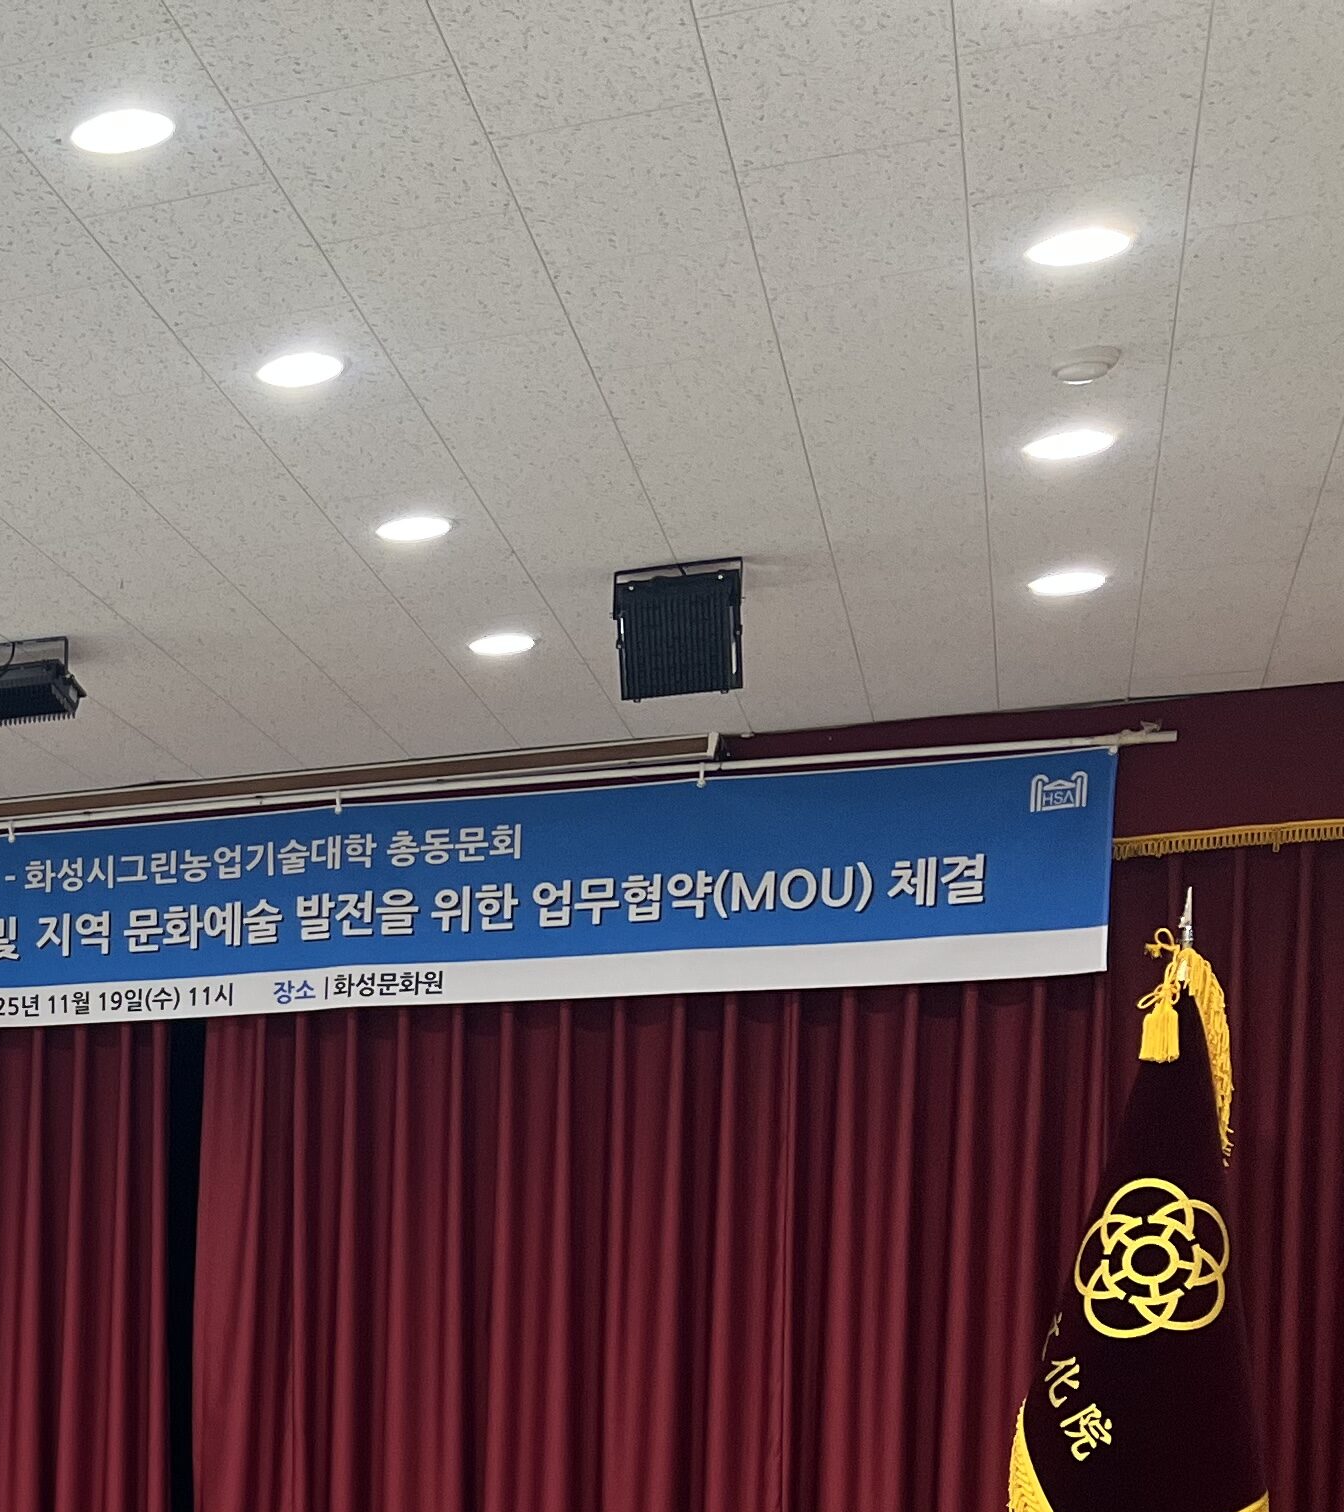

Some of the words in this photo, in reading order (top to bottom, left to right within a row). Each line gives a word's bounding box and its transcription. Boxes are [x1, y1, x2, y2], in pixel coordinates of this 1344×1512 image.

[24, 832, 378, 893] 화성시그린농업기술대학
[386, 823, 522, 868] 총동문회
[36, 910, 111, 957] 지역
[123, 898, 283, 953] 문화예술
[296, 888, 420, 942] 발전을
[431, 882, 519, 933] 위한
[532, 860, 873, 928] 업무협약(MOU)
[887, 852, 988, 908] 체결
[50, 991, 91, 1015] 11월
[98, 986, 181, 1014] 19일(수)
[188, 982, 234, 1007] 11시
[273, 979, 316, 1005] 장소
[333, 970, 445, 998] 화성문화원
